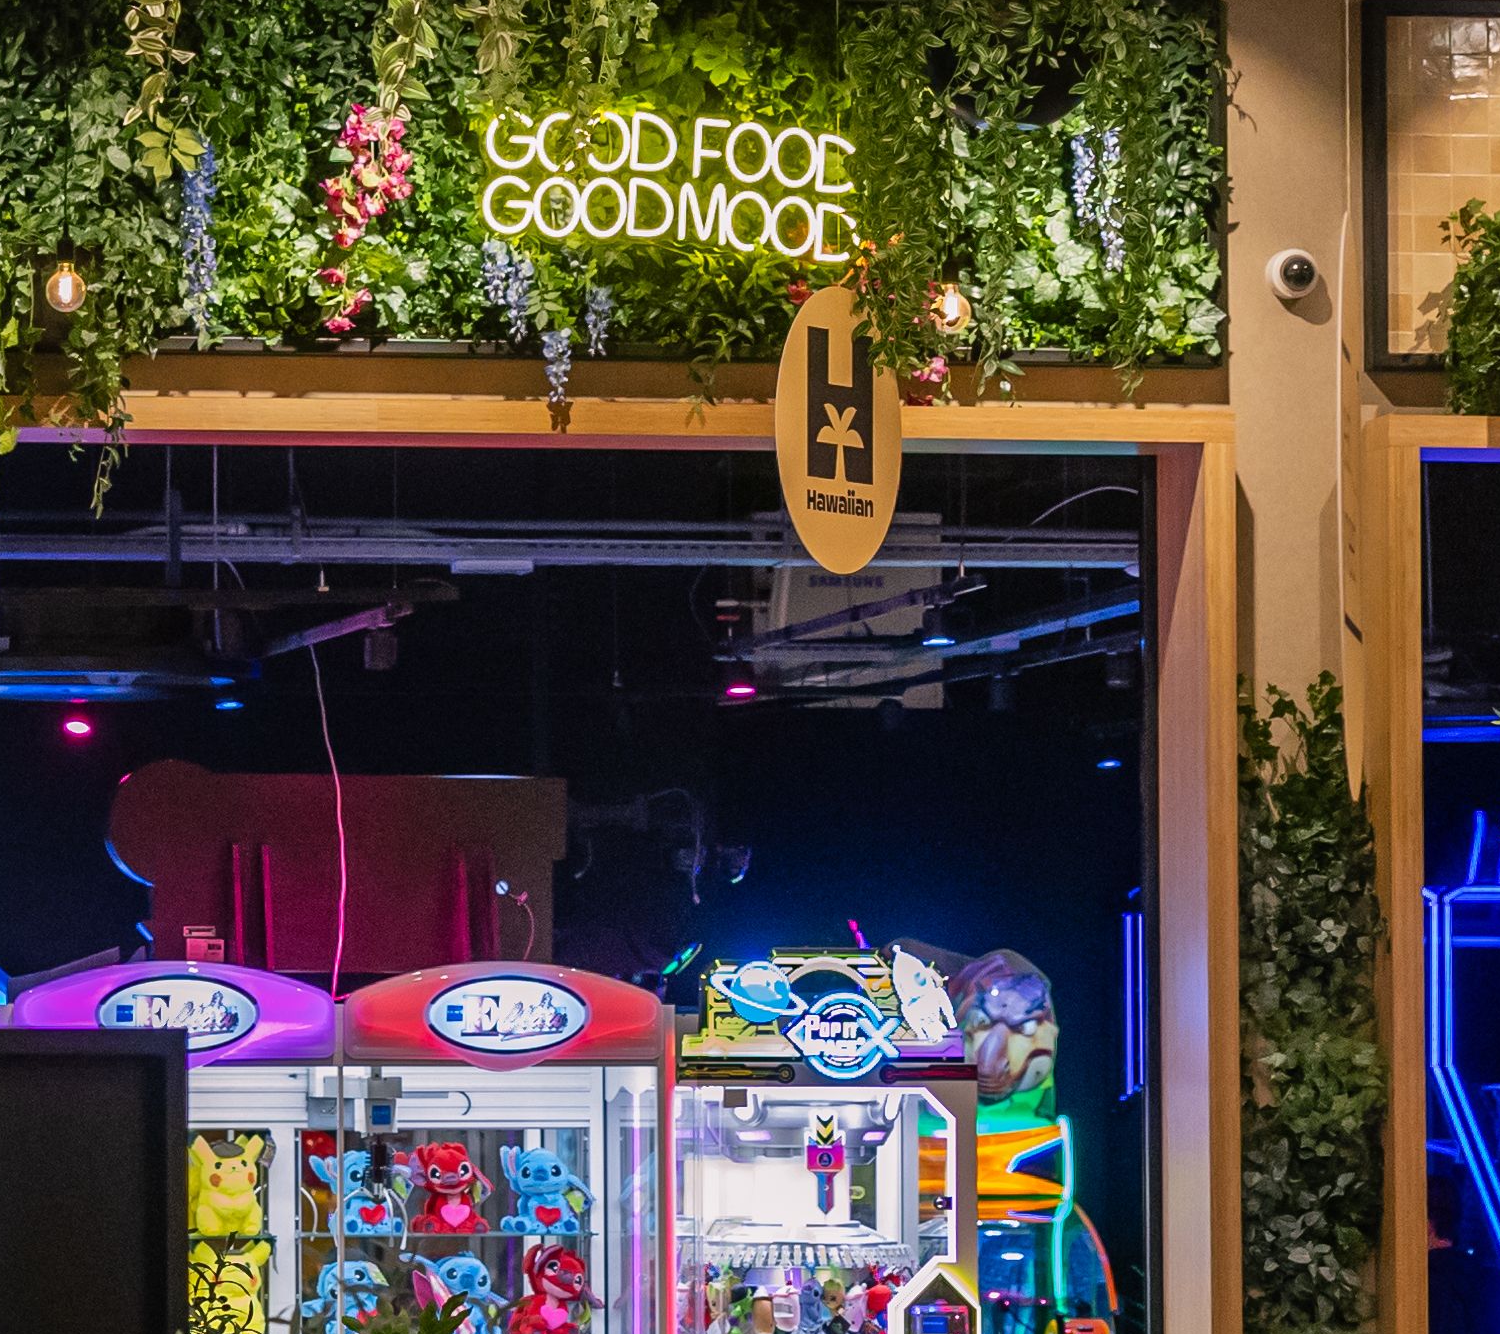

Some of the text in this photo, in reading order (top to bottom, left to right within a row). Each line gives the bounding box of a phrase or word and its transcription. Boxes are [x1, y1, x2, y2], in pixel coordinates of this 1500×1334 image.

[485, 106, 678, 173] GOOD
[481, 175, 862, 262] GOOD MOOD
[806, 488, 874, 519] Hawaiian
